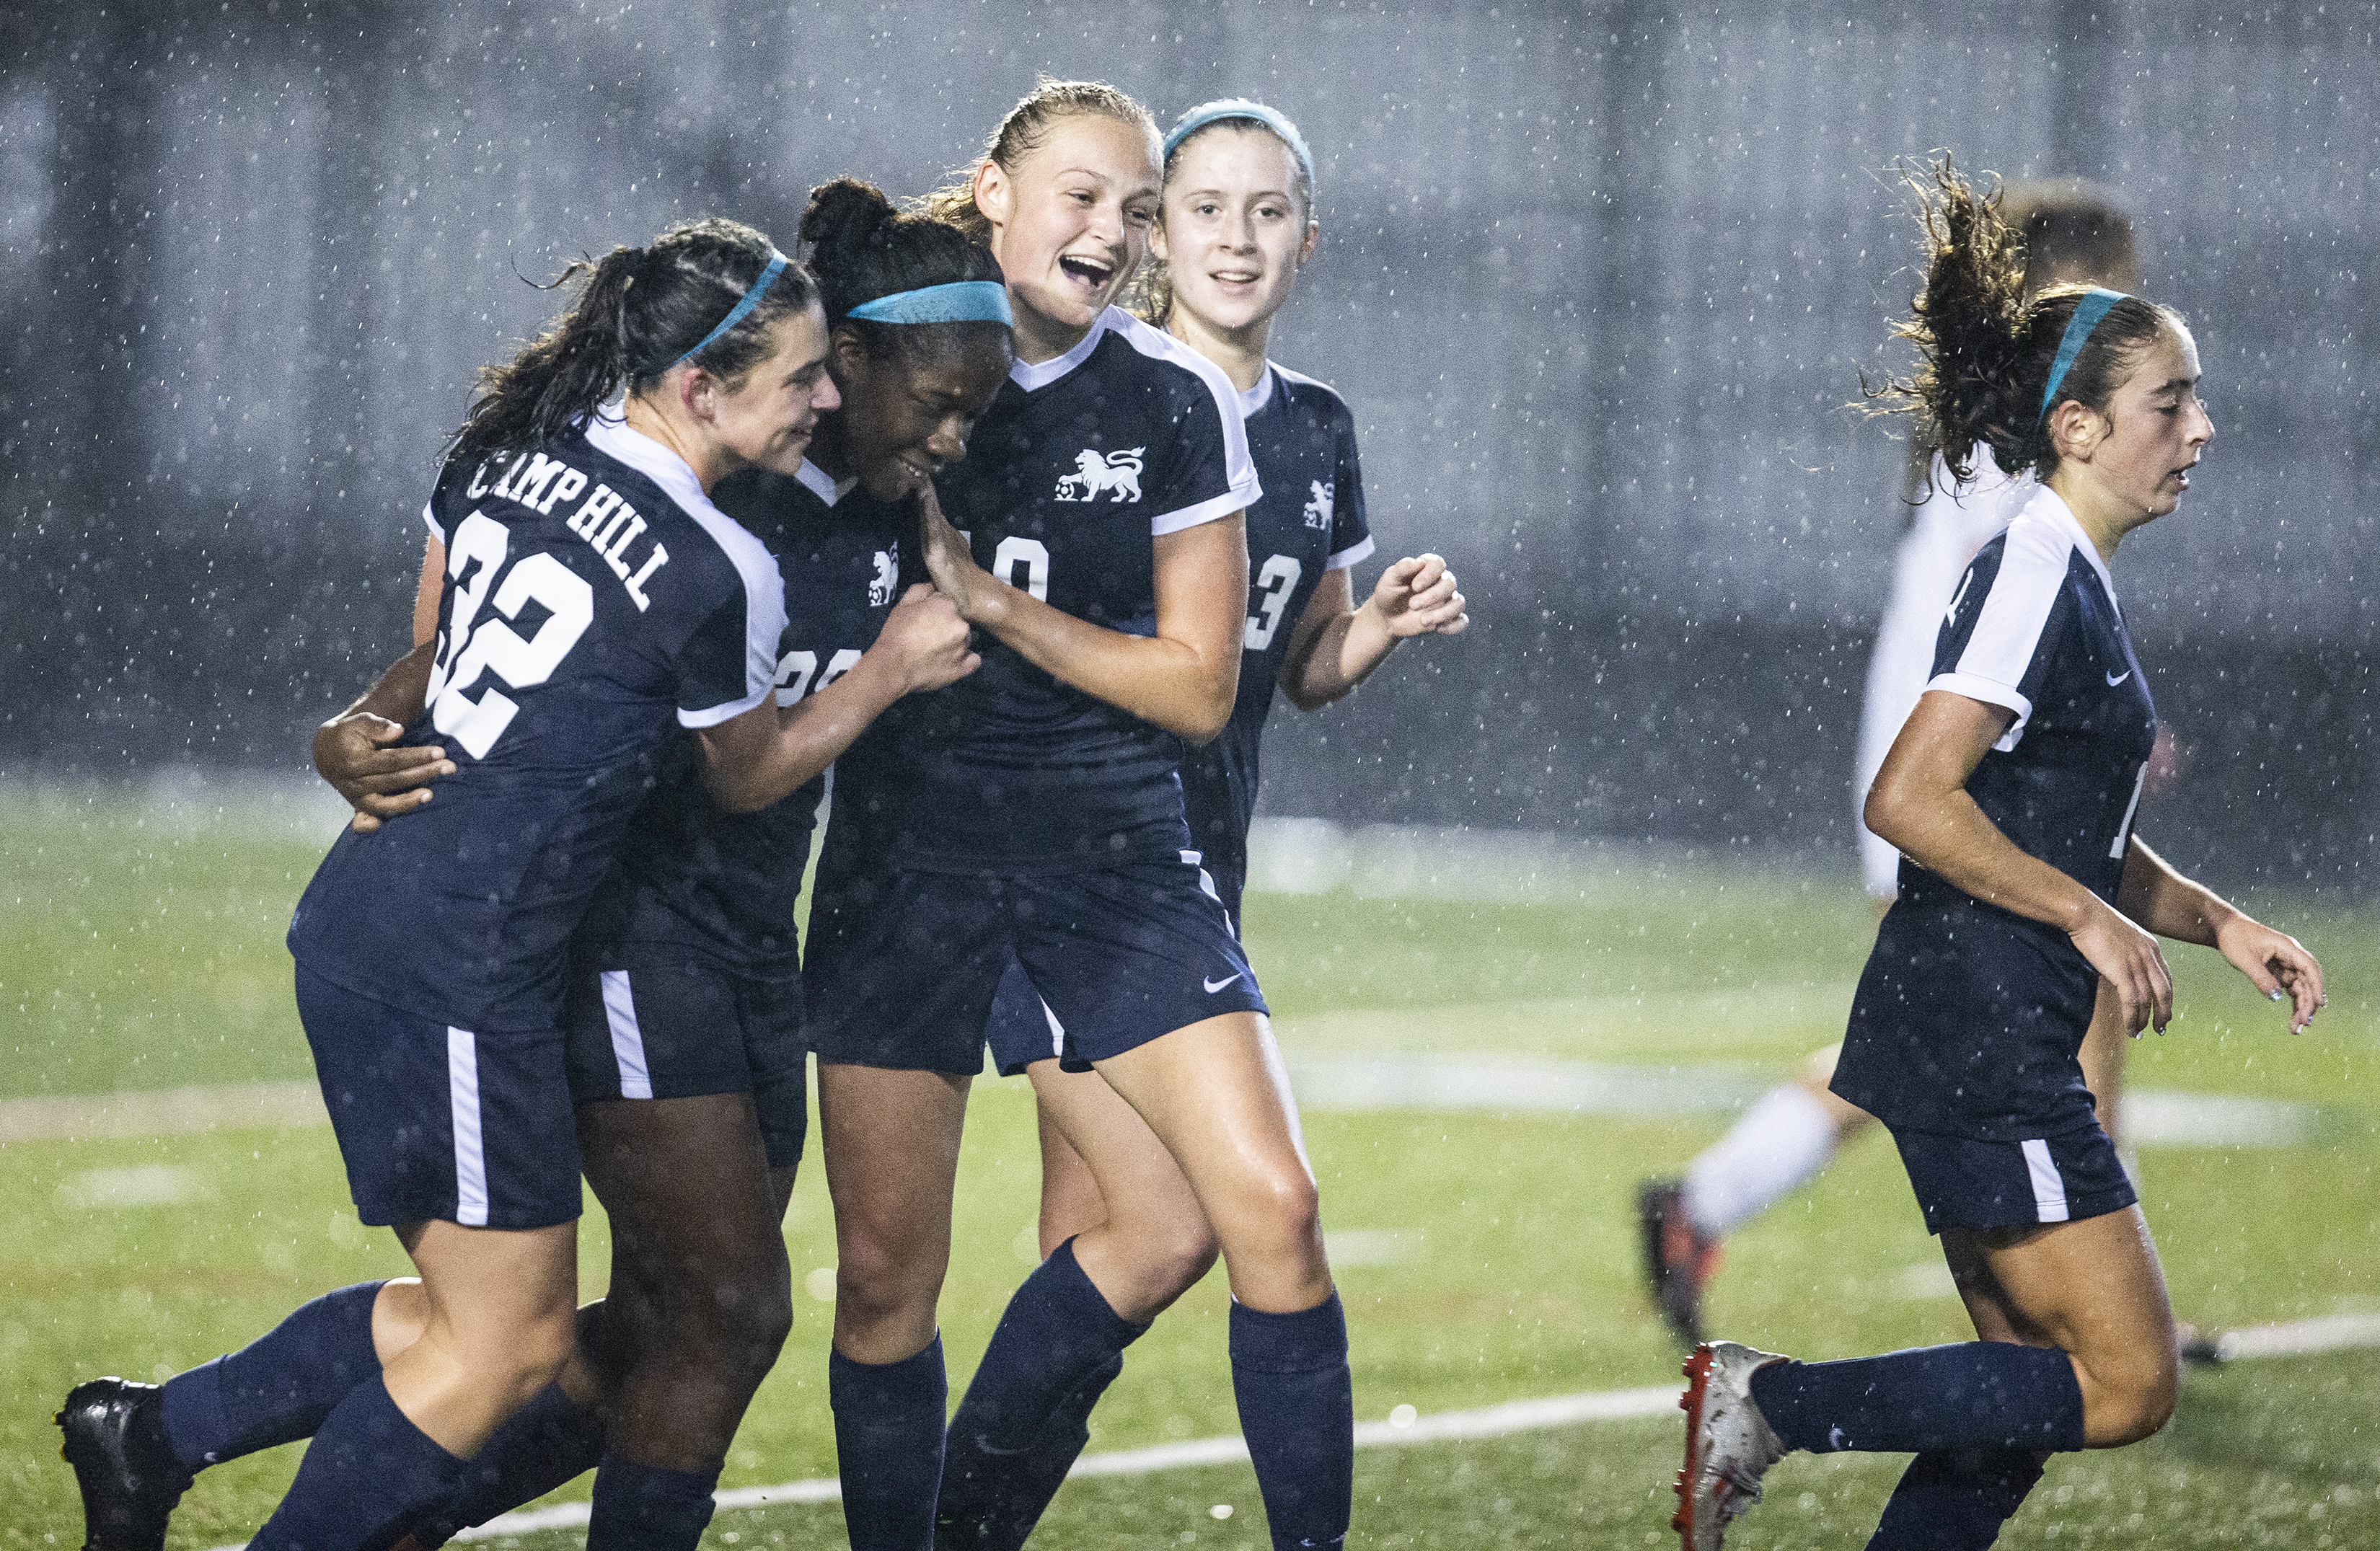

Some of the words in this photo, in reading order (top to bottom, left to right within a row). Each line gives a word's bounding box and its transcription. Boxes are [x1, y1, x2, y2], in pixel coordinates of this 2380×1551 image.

[467, 450, 588, 516] CAMP
[565, 483, 669, 613] HILL
[959, 530, 1049, 602] 0
